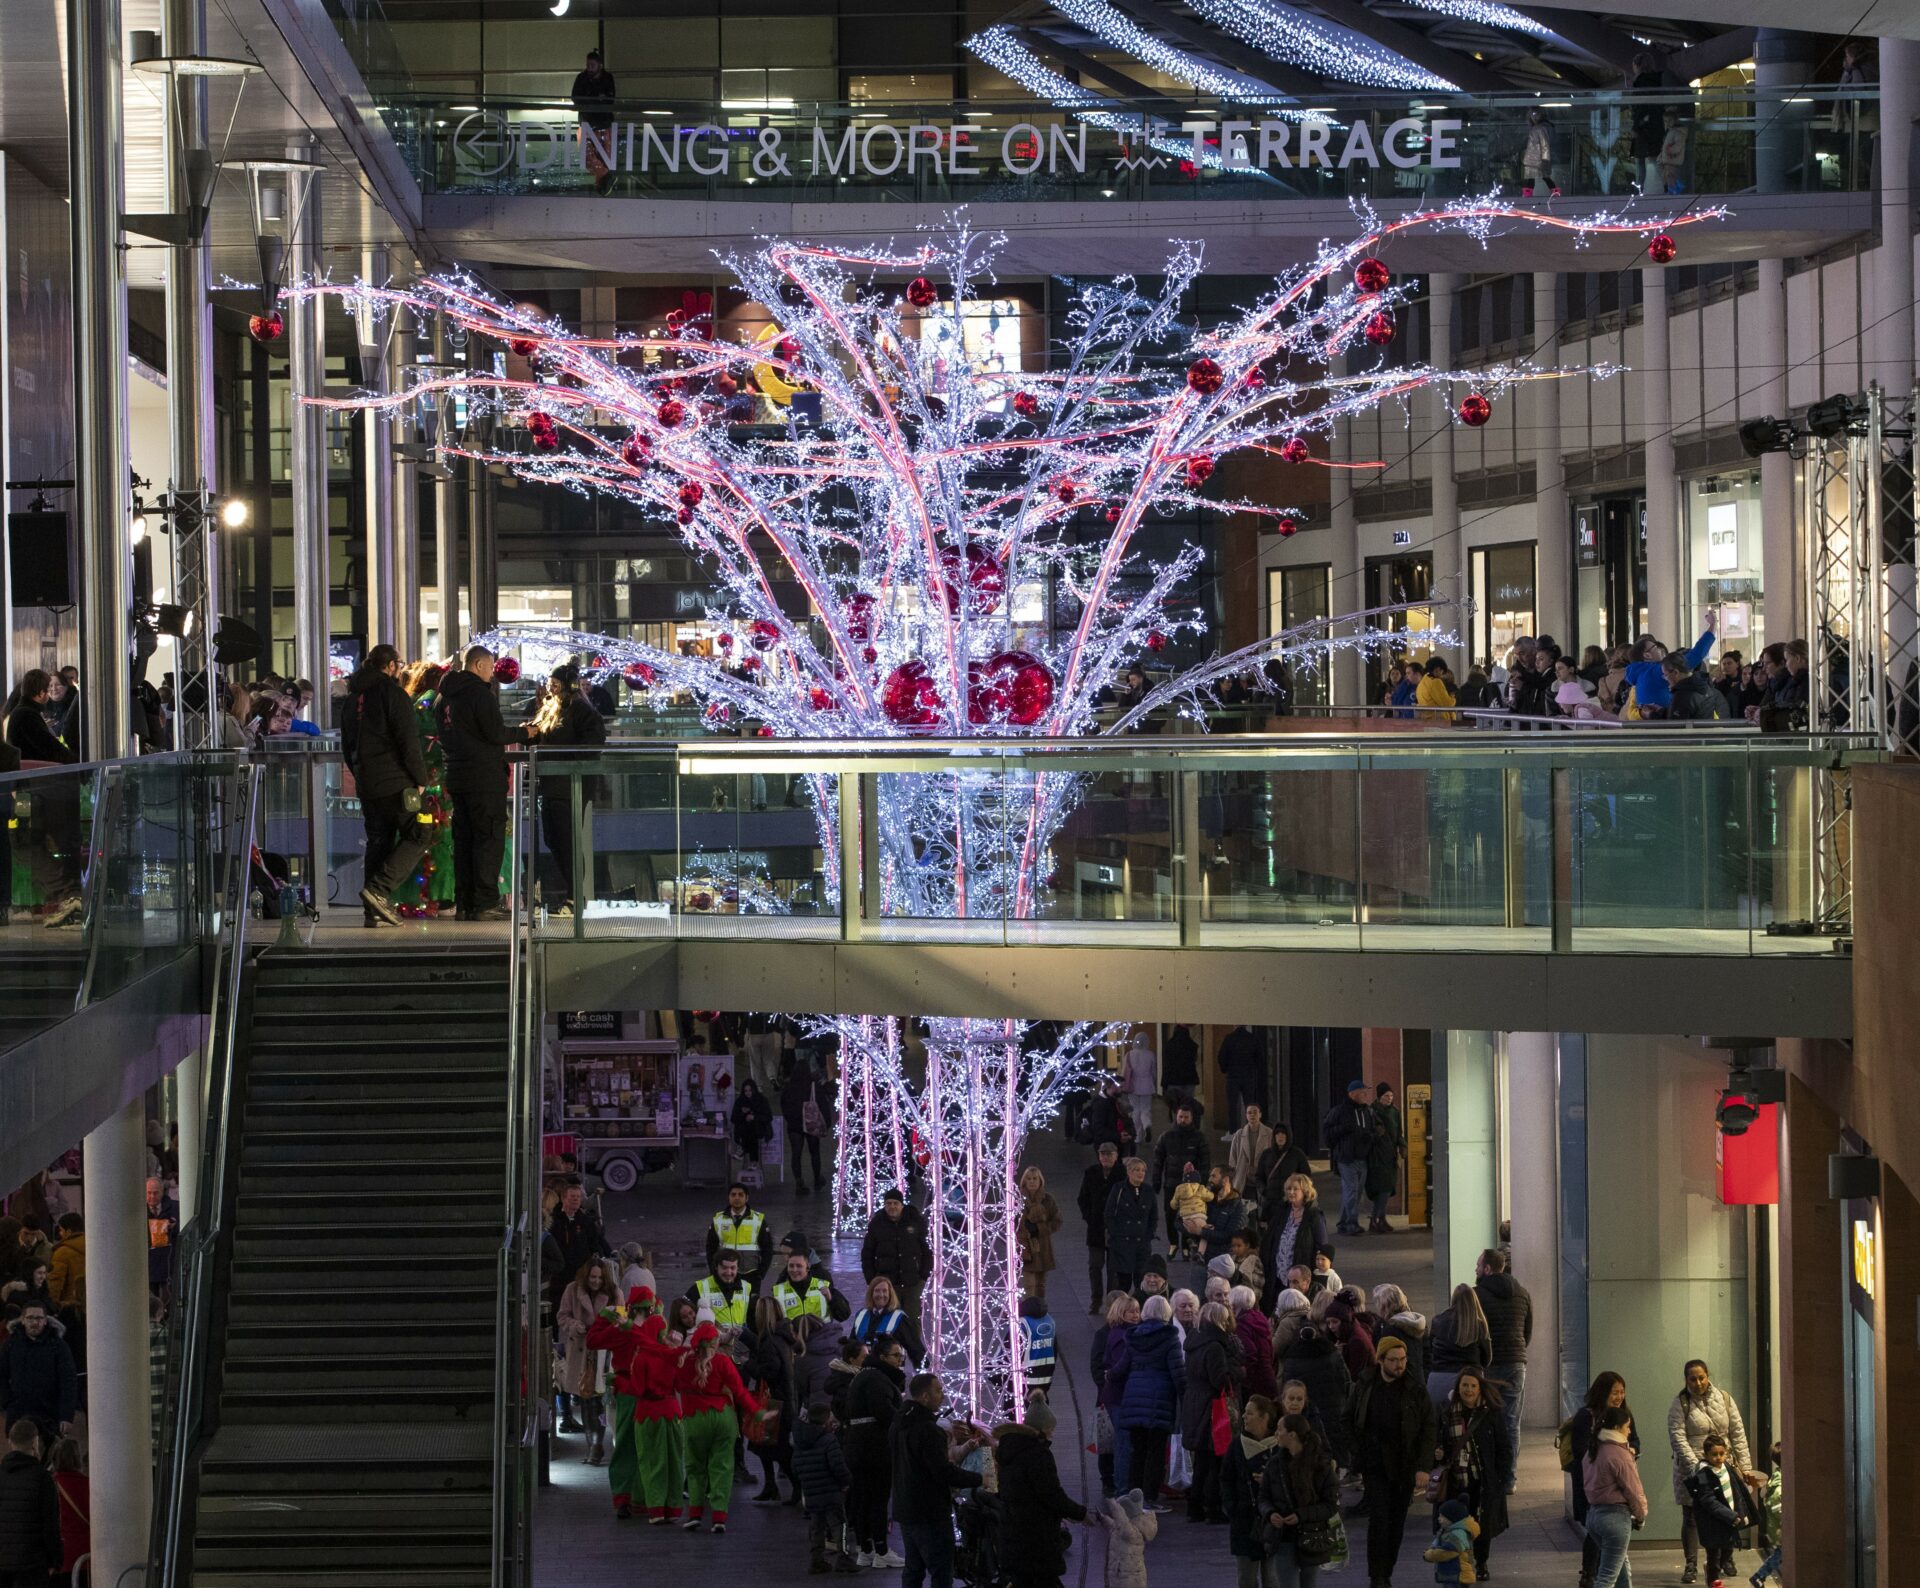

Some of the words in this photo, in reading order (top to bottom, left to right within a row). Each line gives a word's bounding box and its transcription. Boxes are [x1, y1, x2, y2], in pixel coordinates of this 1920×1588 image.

[518, 120, 730, 175] DINING
[752, 126, 793, 177] &
[812, 124, 982, 176] MORE
[1002, 122, 1087, 175] ON
[1113, 122, 1169, 146] THE
[1181, 118, 1463, 169] TERRACE
[677, 592, 715, 611] John
